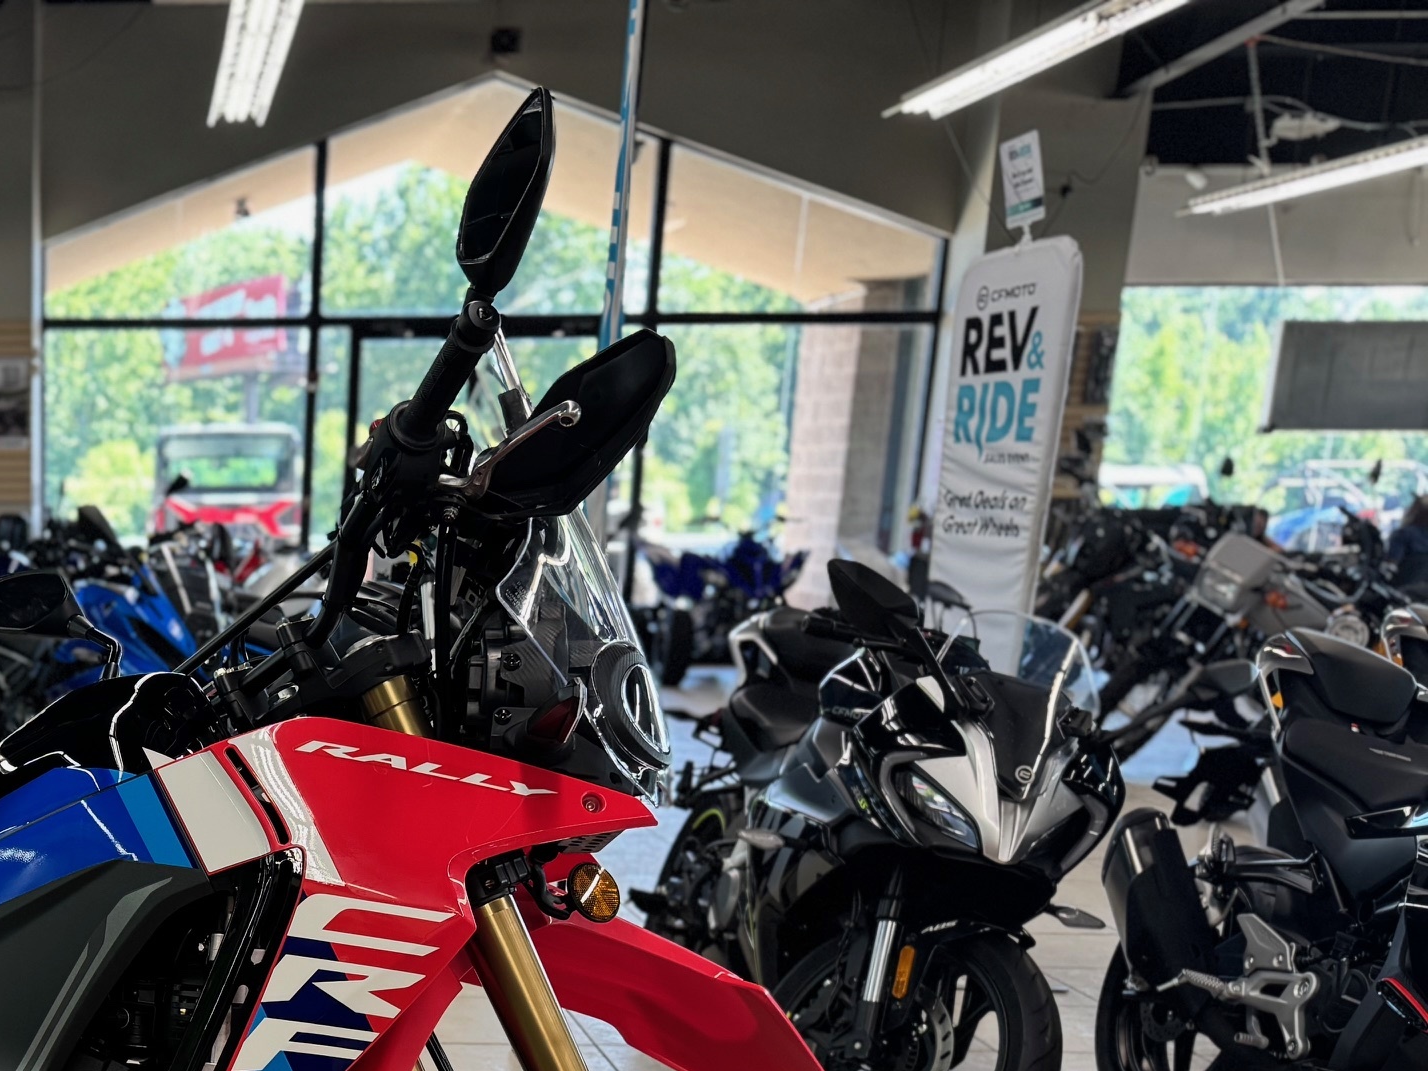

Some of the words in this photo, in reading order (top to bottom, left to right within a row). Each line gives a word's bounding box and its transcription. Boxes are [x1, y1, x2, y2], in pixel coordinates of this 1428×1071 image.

[991, 283, 1036, 302] CFMOTO
[960, 306, 1039, 377] REV
[953, 378, 1041, 459] RIDE
[942, 515, 978, 534] Great
[295, 740, 558, 796] RALLY
